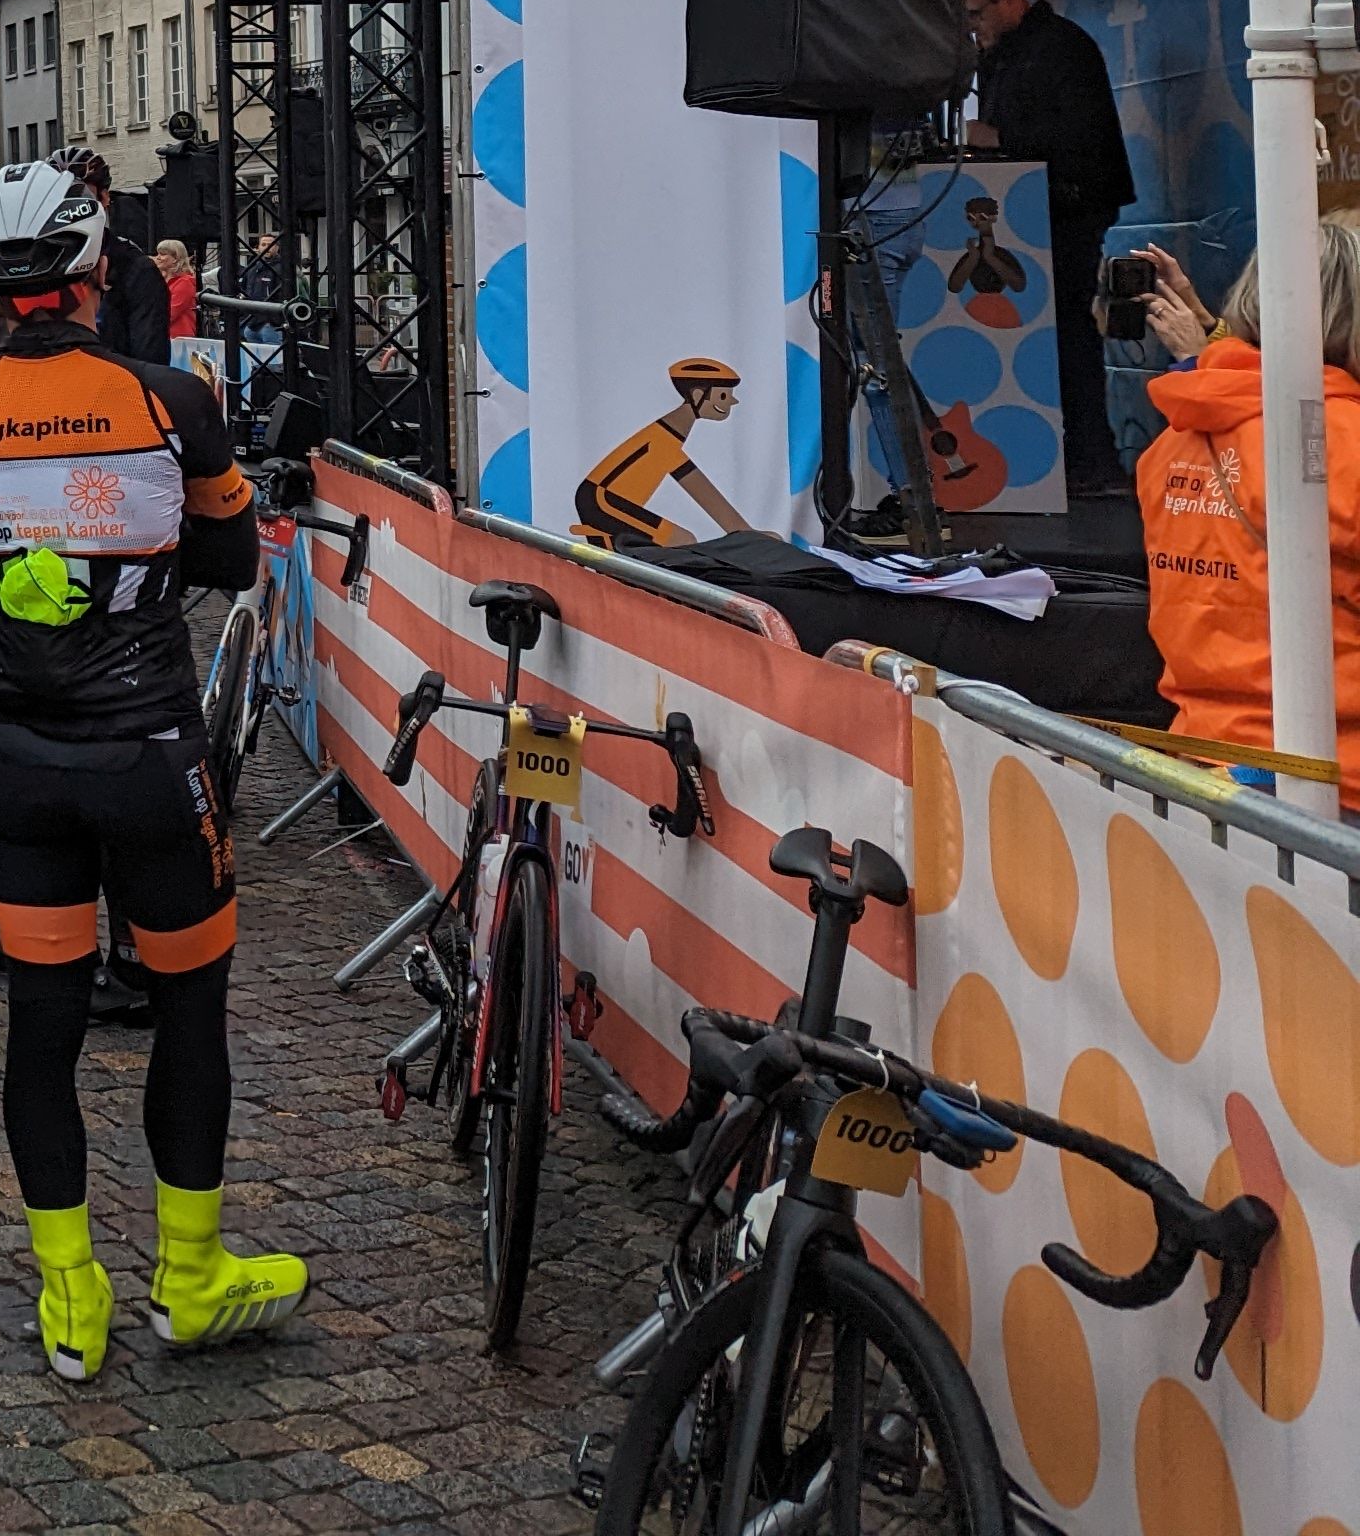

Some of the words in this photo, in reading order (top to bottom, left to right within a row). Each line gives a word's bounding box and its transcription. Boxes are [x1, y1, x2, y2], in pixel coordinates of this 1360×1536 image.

[16, 522, 60, 544] tegen
[65, 520, 127, 538] Kanker
[516, 750, 571, 777] 1000
[185, 765, 202, 801] Kom
[564, 840, 582, 885] GO
[835, 1114, 915, 1155] 1000
